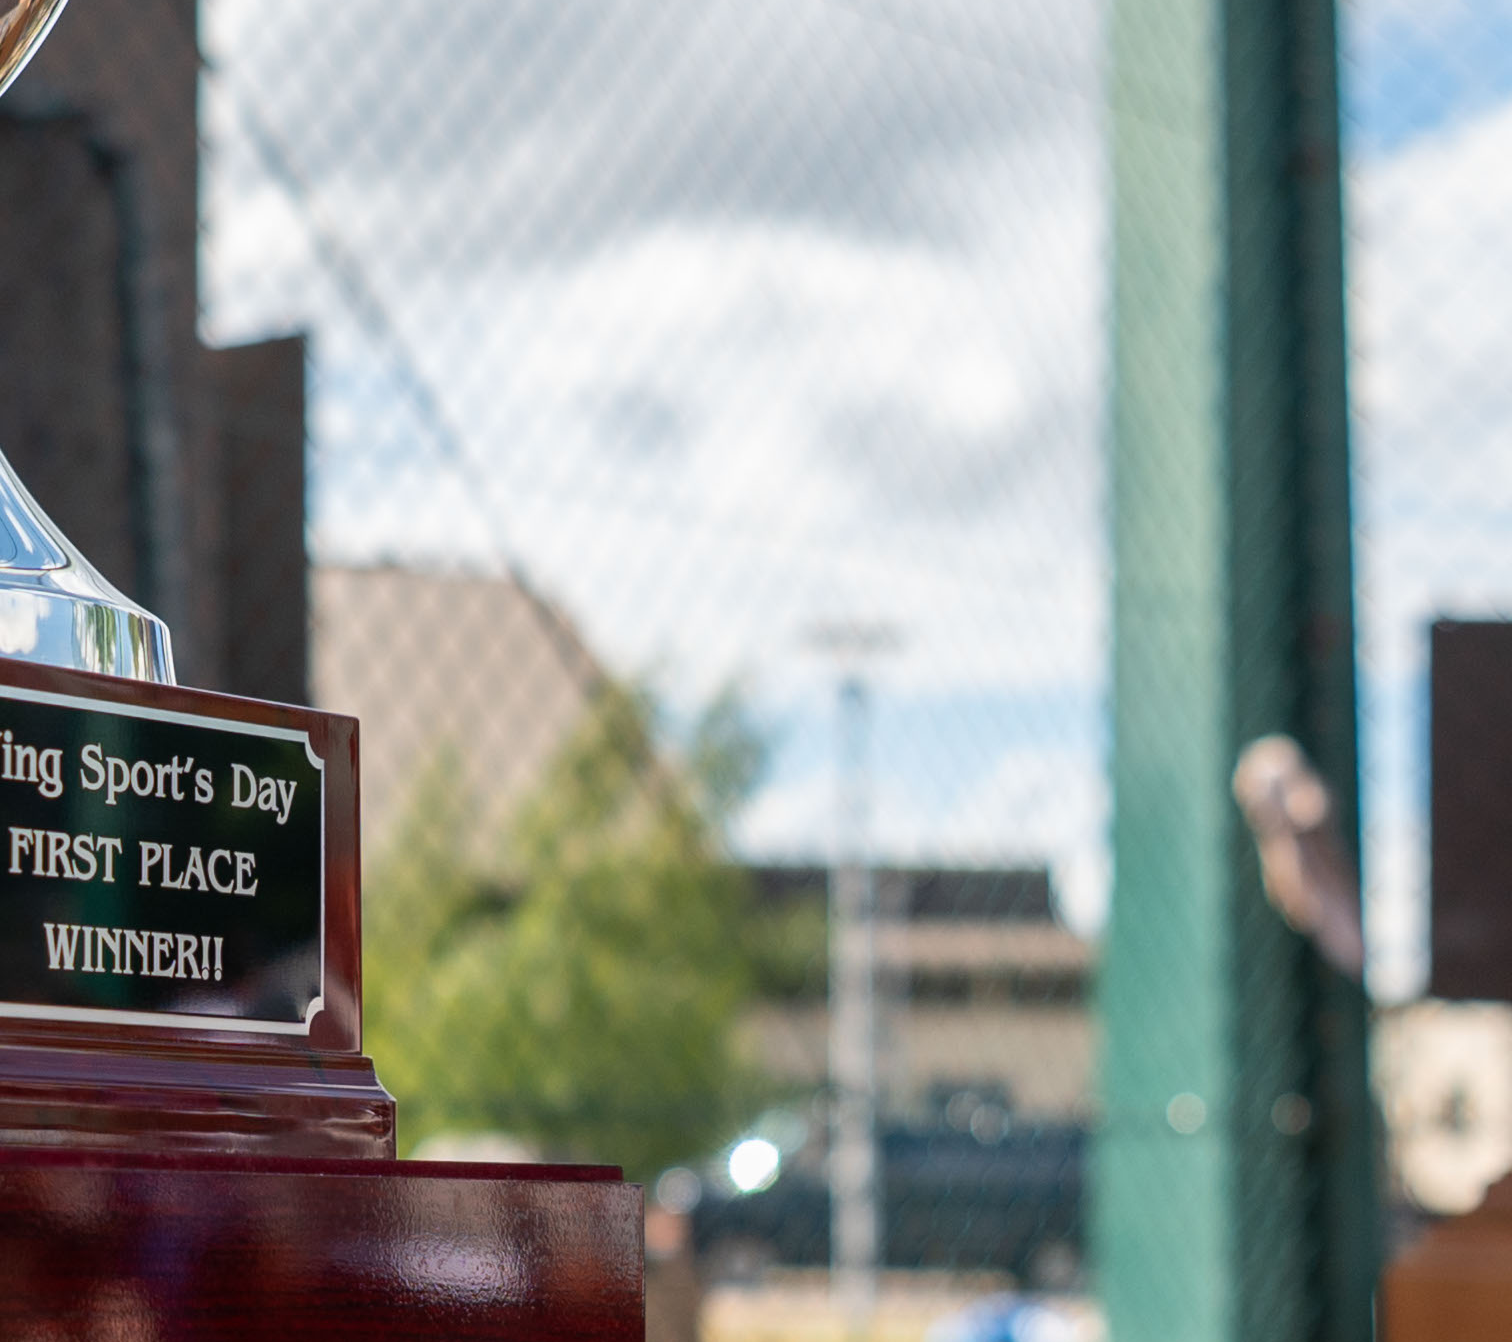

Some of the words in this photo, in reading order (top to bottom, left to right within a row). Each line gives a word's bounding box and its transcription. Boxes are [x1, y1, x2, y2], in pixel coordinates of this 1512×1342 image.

[79, 742, 214, 805] Sport's
[230, 762, 298, 825] Day
[8, 826, 123, 883] FIRST
[138, 841, 259, 897] PLACE
[43, 922, 225, 982] WINNER!!
